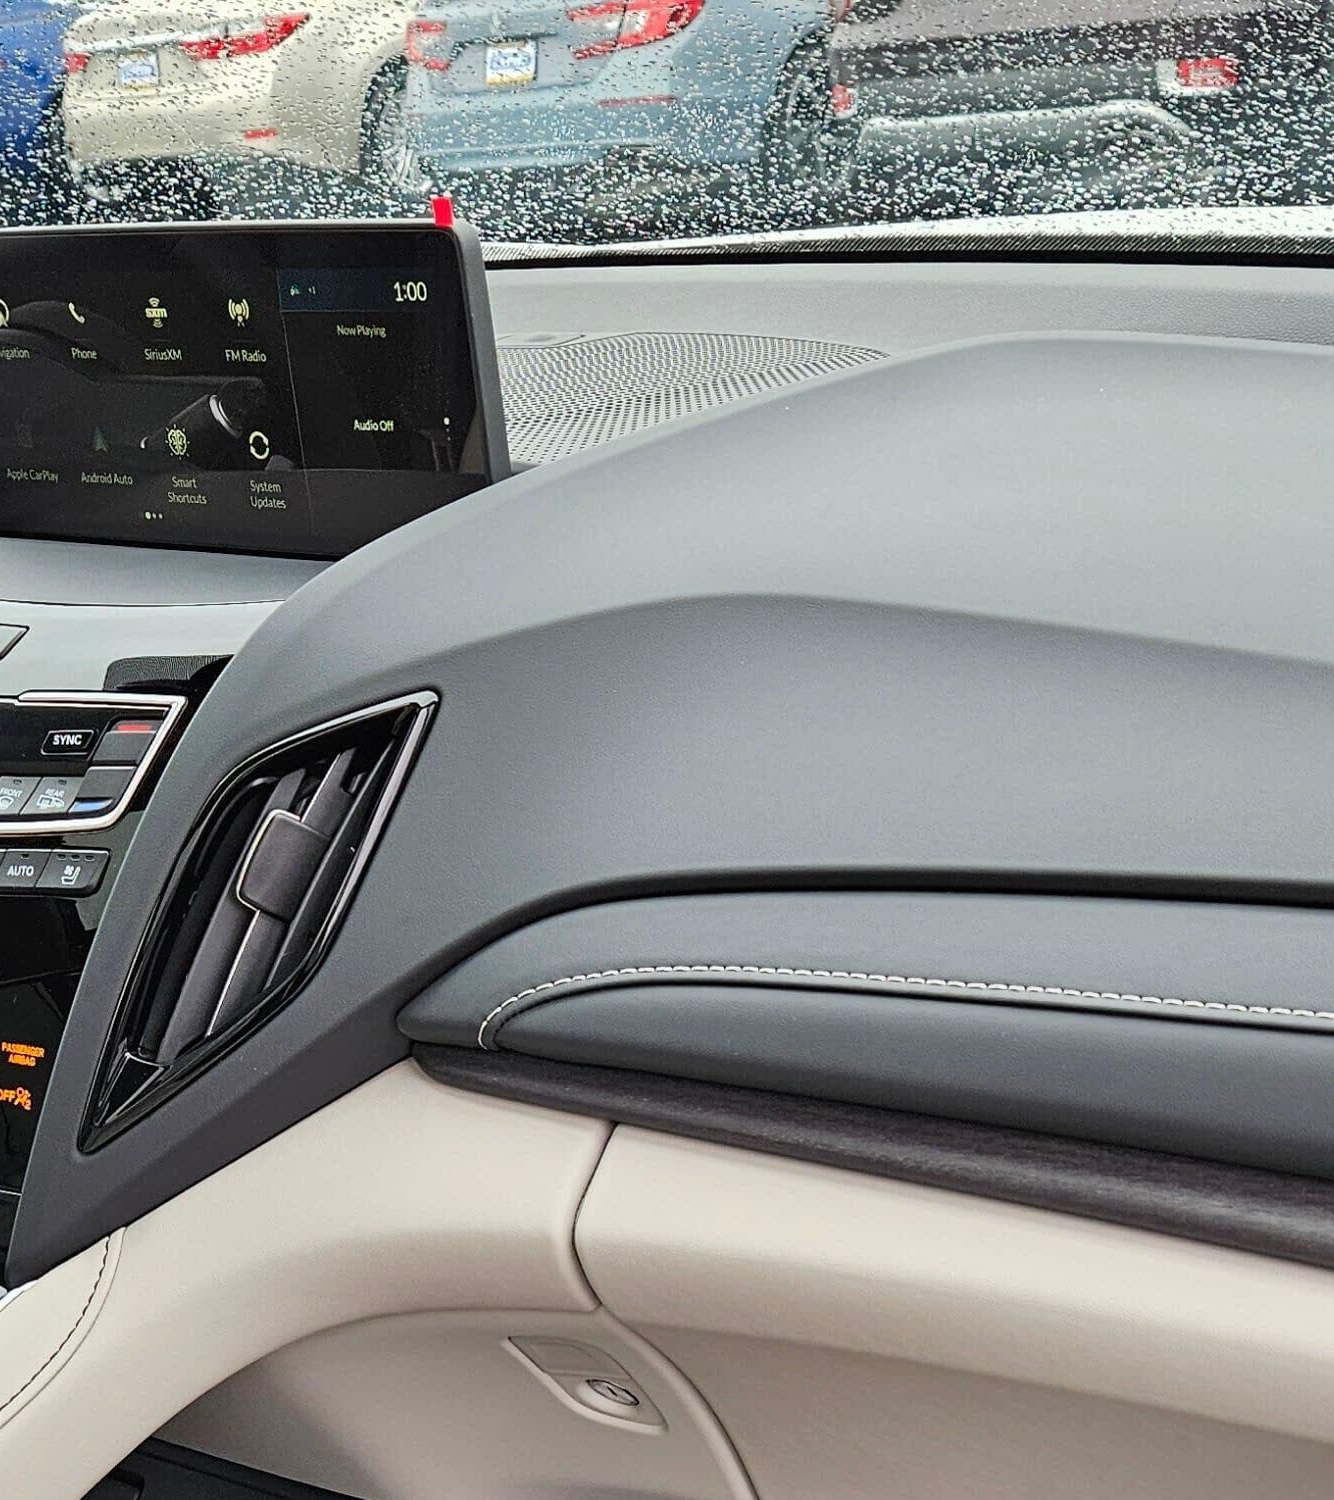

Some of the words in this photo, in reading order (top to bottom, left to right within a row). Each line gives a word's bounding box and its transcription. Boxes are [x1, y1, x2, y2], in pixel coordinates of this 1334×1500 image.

[393, 281, 428, 302] 1:00
[336, 325, 355, 336] Now
[357, 324, 387, 338] Playing
[71, 347, 98, 360] Phone
[144, 348, 183, 361] SiriusXM
[225, 349, 241, 362] FM
[242, 350, 267, 362] Radio
[353, 419, 379, 432] Audio
[379, 419, 394, 432] Off
[7, 468, 28, 481] Apple
[29, 469, 59, 483] CarPlay
[81, 472, 112, 485] Android
[113, 473, 133, 485] Auto
[171, 476, 198, 488] Smart
[250, 480, 282, 493] System
[167, 491, 207, 504] Shortcuts
[250, 496, 287, 509] Updates
[51, 734, 83, 746] SYNC
[0, 787, 22, 798] FRONT
[45, 788, 65, 798] REAR
[7, 865, 34, 877] AUTO
[1, 1041, 45, 1058] PASSENGER
